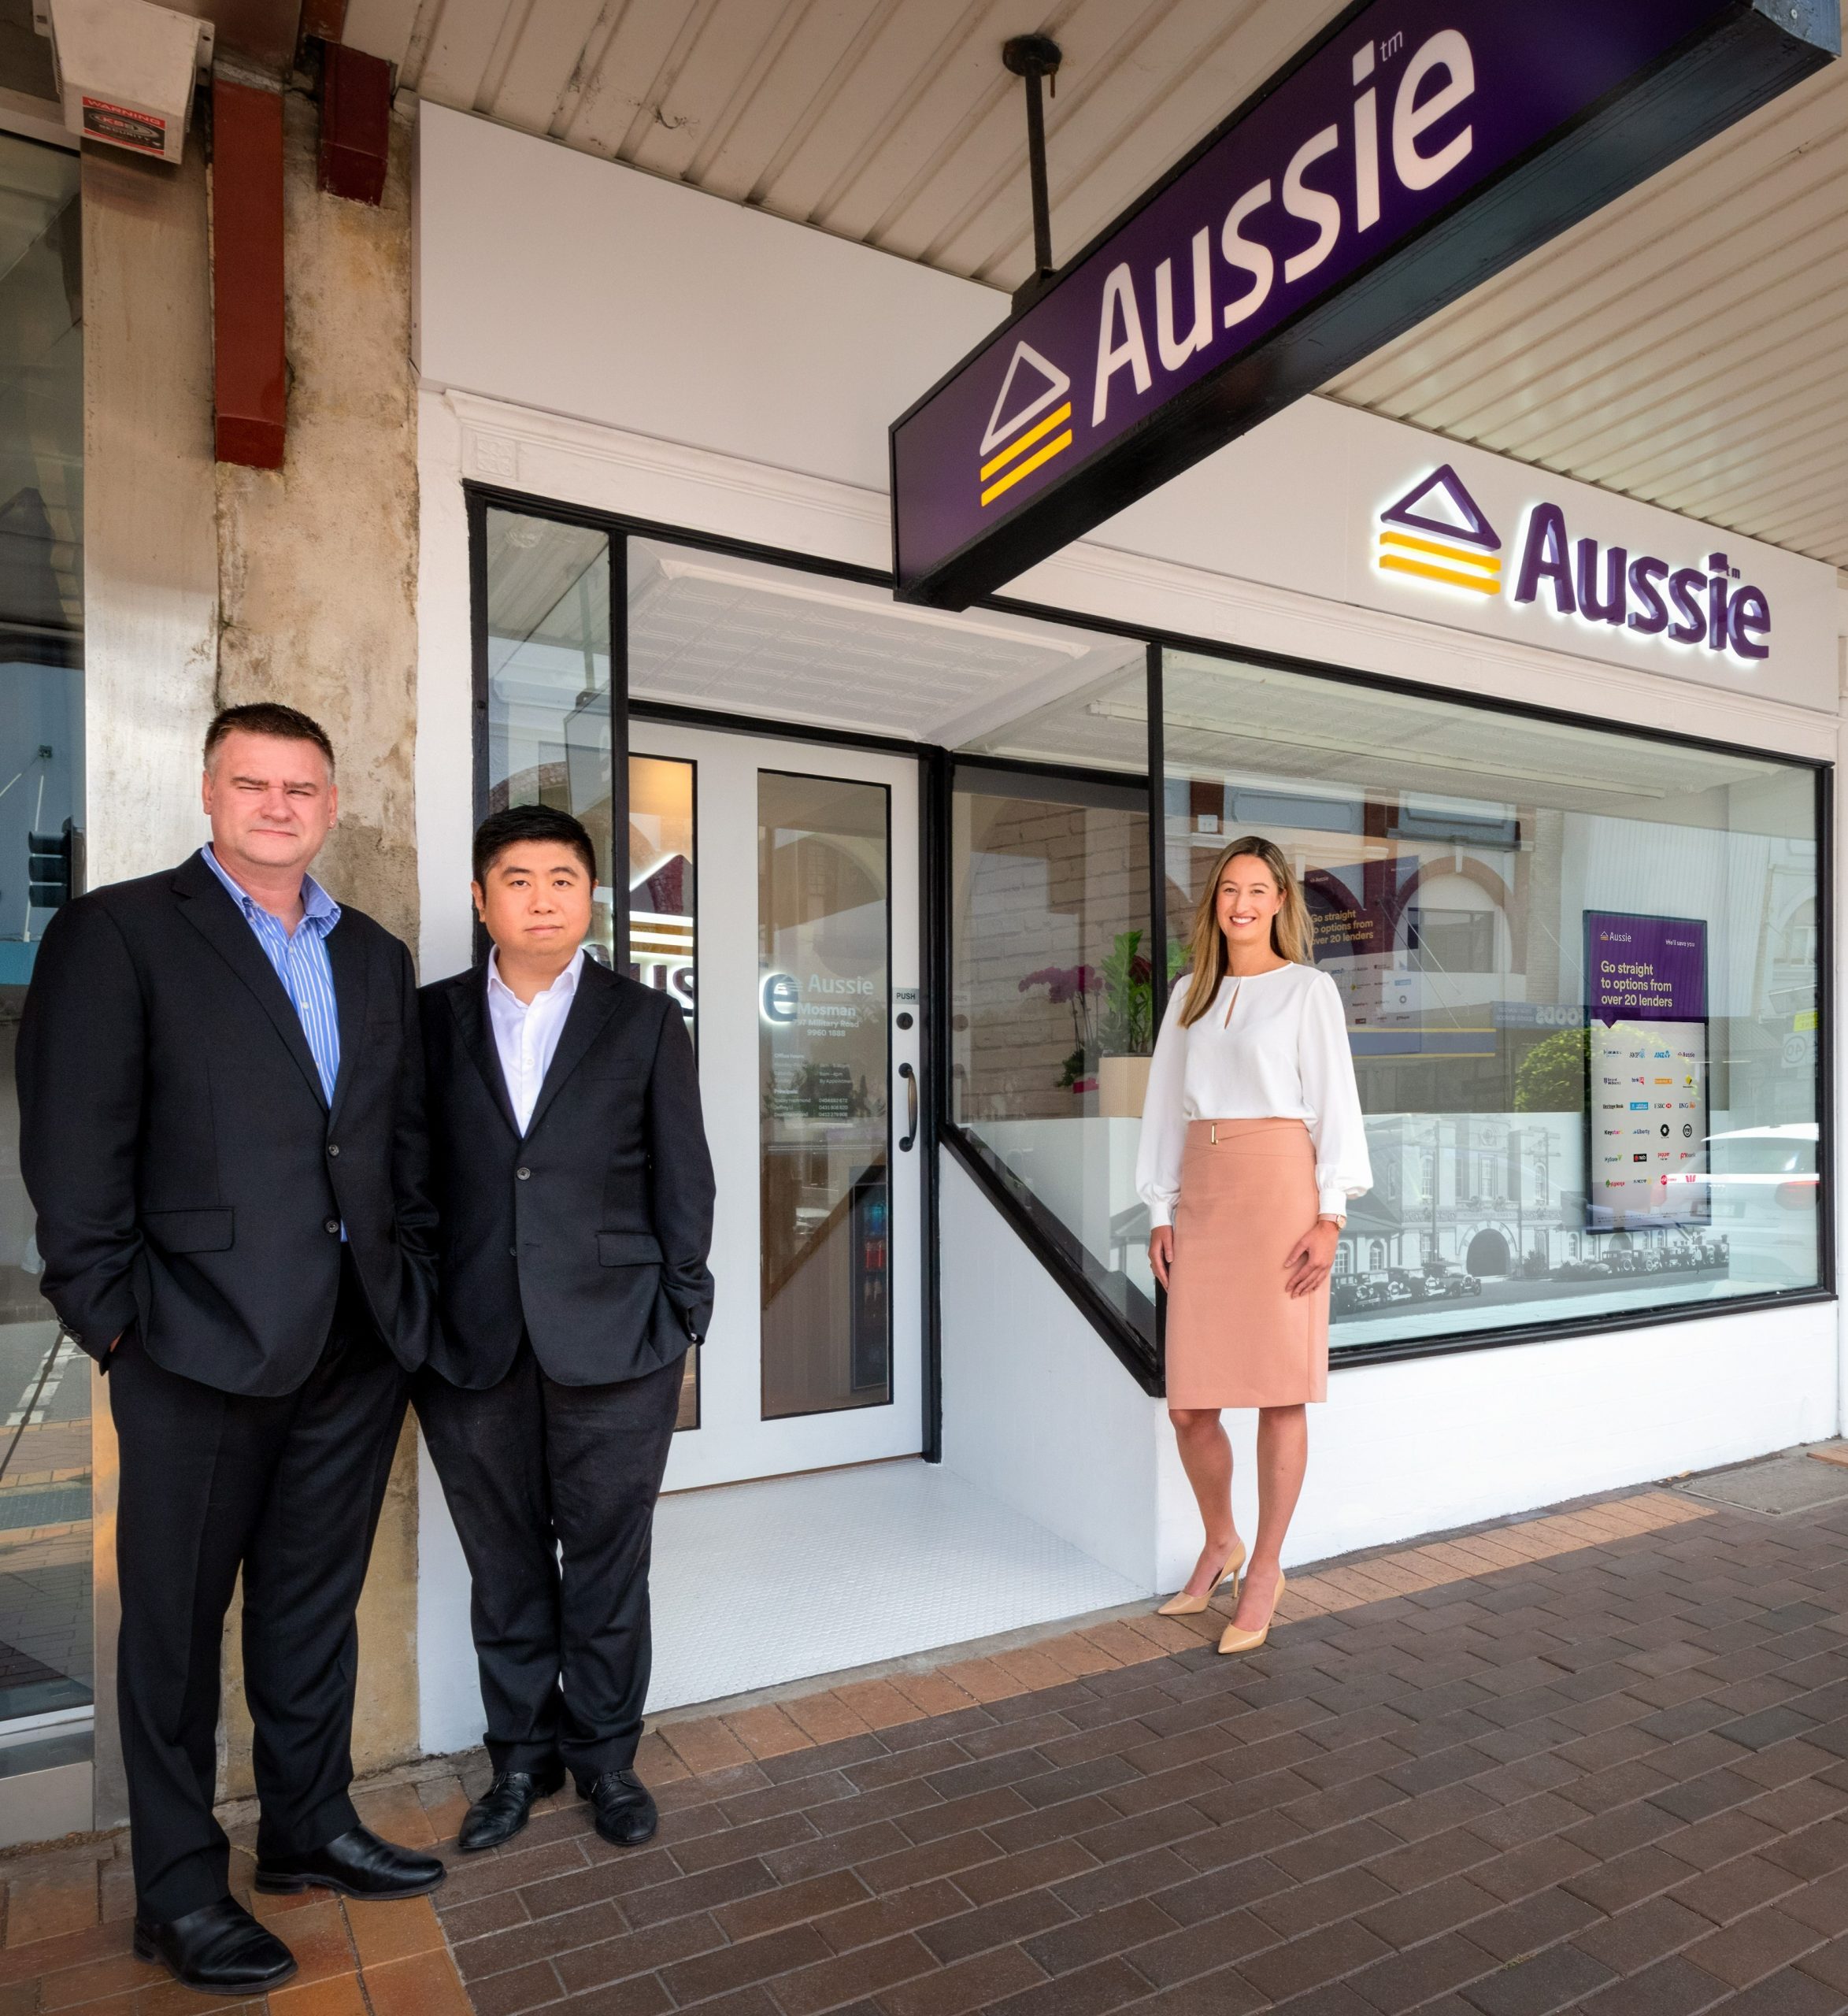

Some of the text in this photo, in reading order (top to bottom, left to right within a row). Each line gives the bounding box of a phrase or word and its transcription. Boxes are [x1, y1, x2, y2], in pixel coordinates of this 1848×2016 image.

[87, 99, 161, 125] WARNING
[1091, 28, 1476, 428] Aussie
[1514, 502, 1771, 660] Aussie
[1311, 910, 1356, 923] Go straight
[1320, 922, 1351, 934] options
[1354, 920, 1373, 928] from
[1330, 934, 1341, 943] 20
[1342, 931, 1374, 942] lenders
[1609, 932, 1631, 943] Aussie
[1601, 960, 1654, 978] Go straight
[808, 973, 874, 995] Aussie
[1601, 977, 1672, 992] to options from
[1601, 994, 1673, 1007] over 20 lenders
[797, 1002, 857, 1017] Mosman
[808, 1019, 840, 1029] Military
